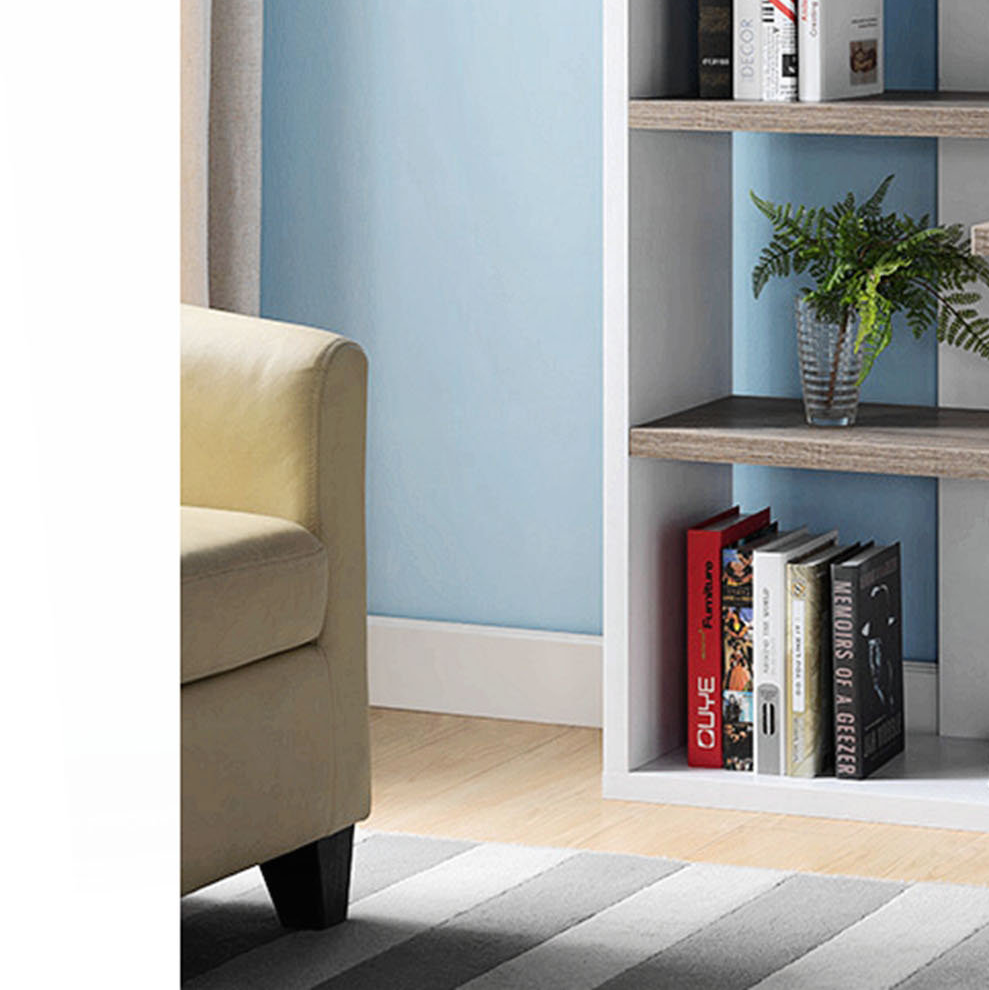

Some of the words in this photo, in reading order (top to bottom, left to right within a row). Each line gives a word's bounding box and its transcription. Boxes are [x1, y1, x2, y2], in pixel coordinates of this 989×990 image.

[702, 561, 715, 629] Furniture
[834, 578, 855, 661] MEMOIRS
[834, 666, 853, 687] OF
[835, 693, 854, 706] A
[836, 709, 858, 774] GEEZER
